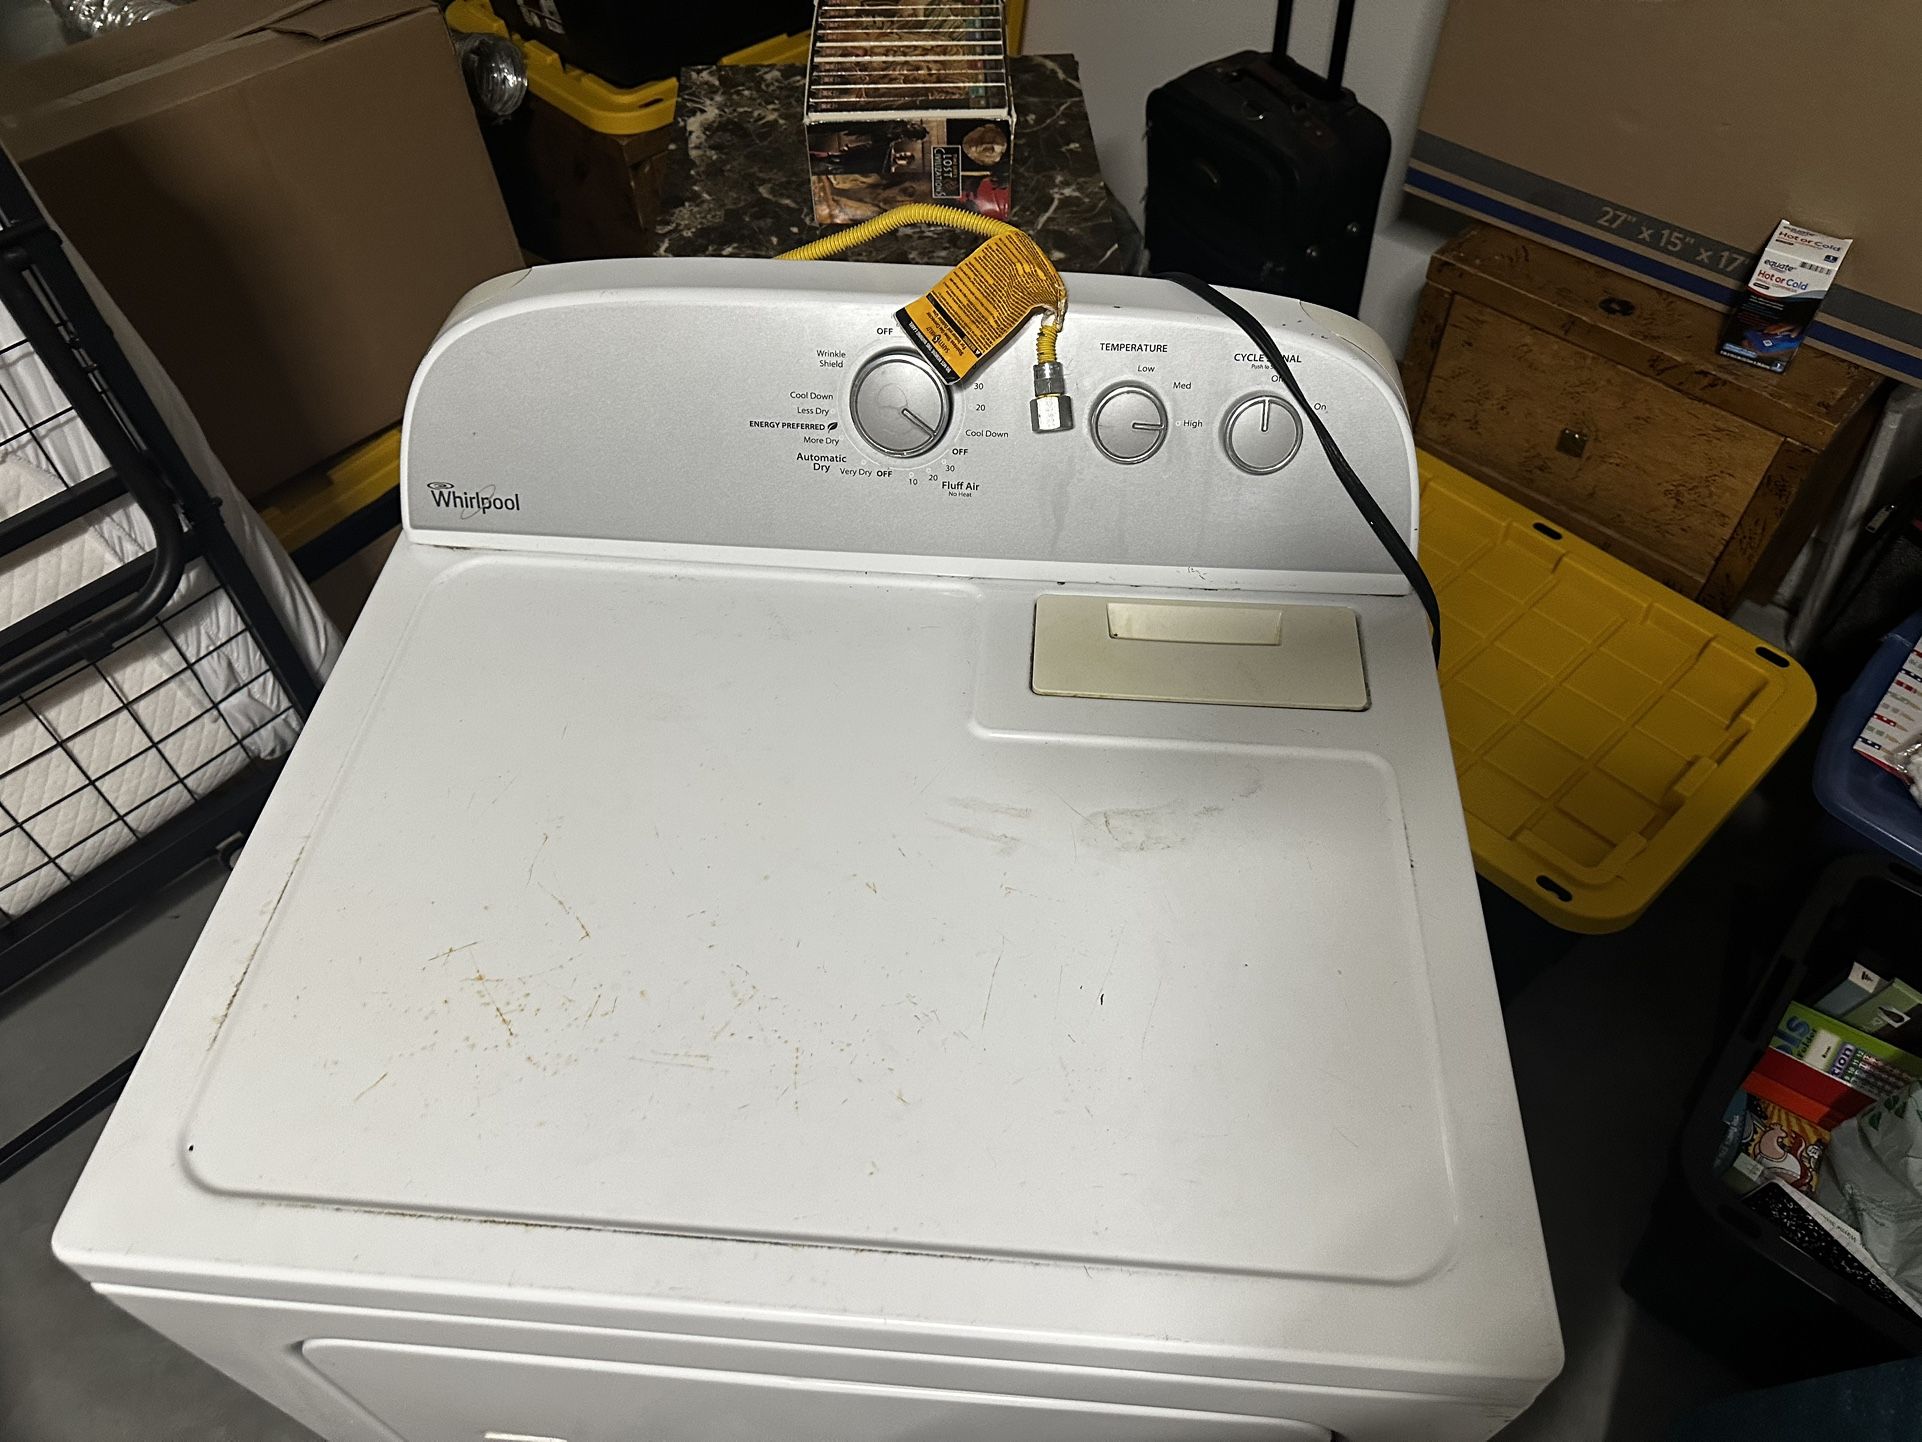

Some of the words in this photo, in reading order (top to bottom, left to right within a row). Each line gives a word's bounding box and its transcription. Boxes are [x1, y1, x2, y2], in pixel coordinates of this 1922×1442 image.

[943, 154, 952, 177] LOST
[934, 147, 945, 196] CIVILIZATIONS
[1596, 206, 1637, 228] 27"
[1638, 226, 1654, 243] x
[1658, 228, 1695, 252] 15"
[1696, 247, 1713, 264] x
[1778, 230, 1800, 241] Hot
[1814, 241, 1841, 252] Cold
[1764, 258, 1794, 272] equate
[1757, 269, 1774, 281] Hot
[1774, 276, 1785, 284] or
[1786, 278, 1808, 291] Cold
[1100, 343, 1167, 352] TEMPERATURE
[817, 350, 846, 358] Wrinkle
[1234, 353, 1264, 361] CYCLE
[820, 360, 843, 368] Shield
[974, 382, 984, 390] 30
[790, 391, 808, 399] Cool
[816, 408, 829, 416] Dry
[1184, 420, 1202, 428] High
[825, 437, 840, 446] Dry
[797, 453, 846, 463] Automatic
[814, 461, 832, 473] Dry
[840, 468, 857, 476] Very
[859, 469, 872, 477] Dry
[942, 481, 964, 490] Fluff
[965, 482, 979, 490] Air
[431, 490, 520, 514] Whirlpool
